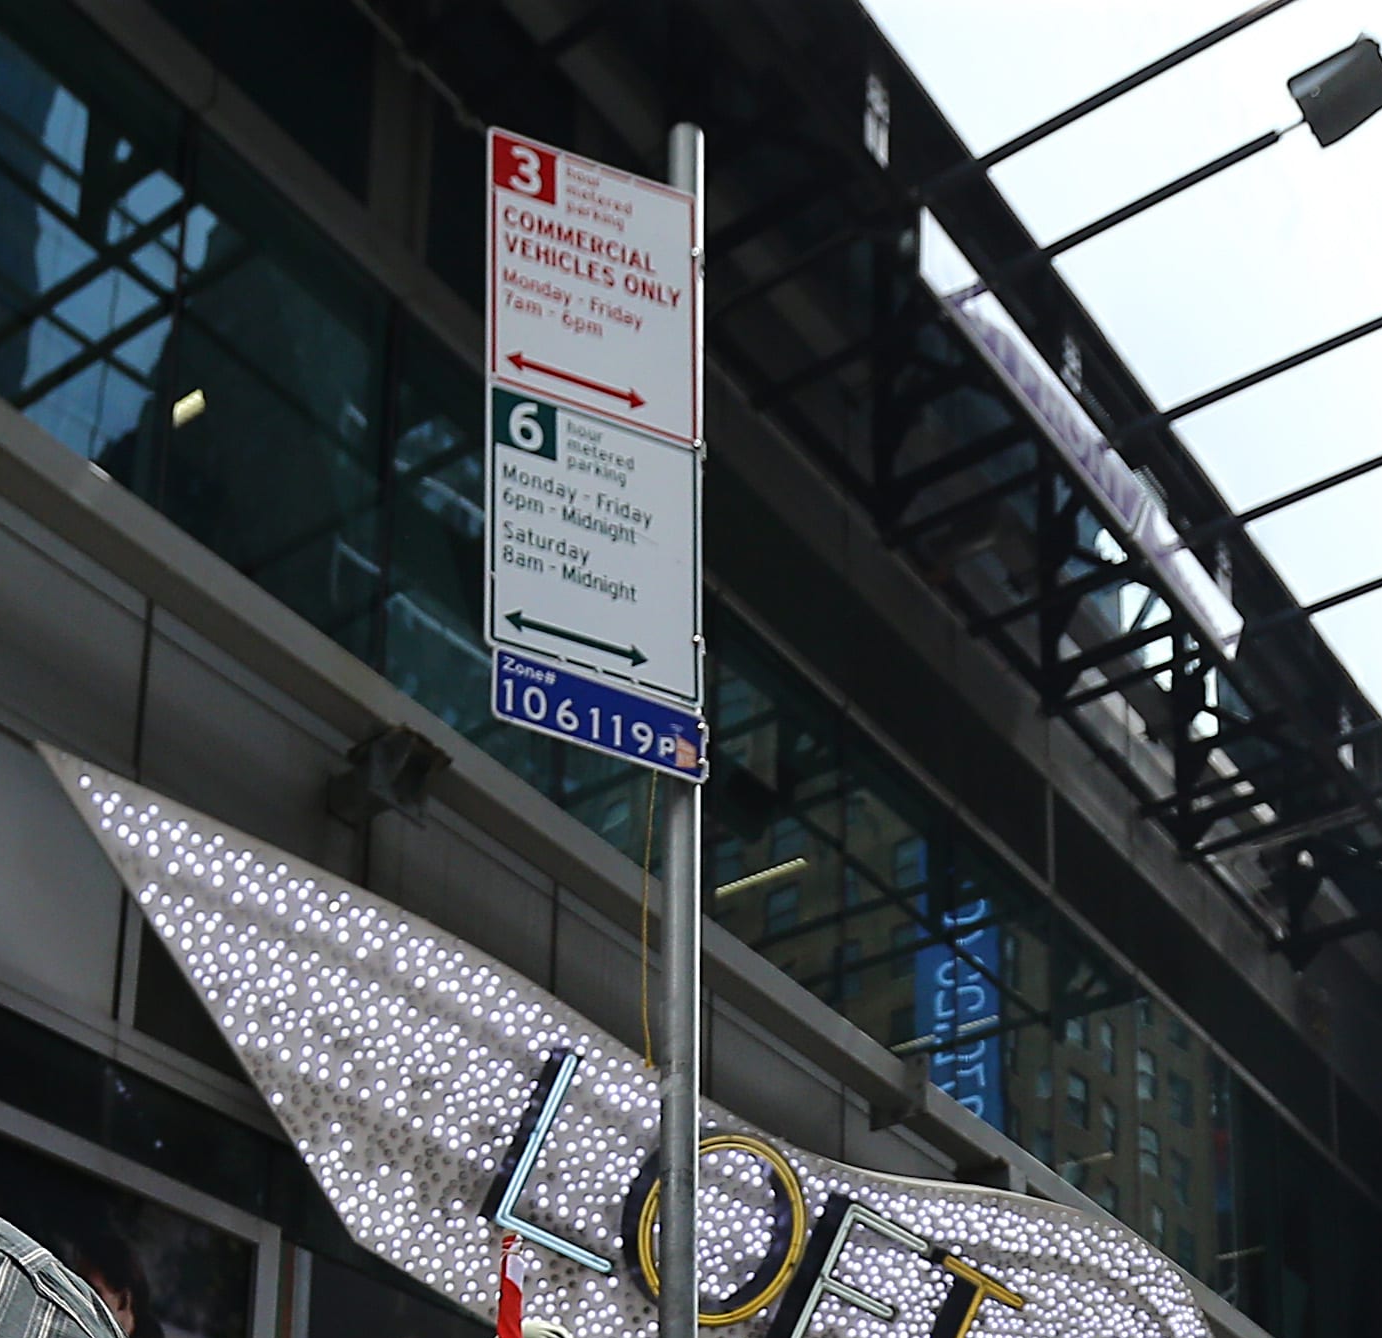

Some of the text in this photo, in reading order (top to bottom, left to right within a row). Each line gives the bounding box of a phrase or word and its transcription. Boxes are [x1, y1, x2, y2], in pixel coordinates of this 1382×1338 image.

[509, 146, 542, 195] 3
[504, 205, 656, 274] COMMERCIAL
[505, 231, 681, 309] VEHICLES ONLY
[503, 267, 572, 305] Monday
[589, 296, 643, 330] Friday
[504, 289, 543, 316] 7am
[562, 310, 603, 337] 6pm
[509, 401, 544, 452] 6
[567, 420, 602, 441] hour
[567, 440, 635, 470] metered
[567, 456, 627, 488] parking
[503, 462, 577, 505] Monday
[598, 493, 653, 530] Friday
[503, 486, 544, 514] 6pm
[562, 505, 637, 545] Midnight
[503, 520, 590, 567] Saturday
[503, 544, 544, 573] 8am
[562, 562, 637, 602] Midnight
[502, 656, 557, 685] Zone#
[503, 678, 654, 755] 106119
